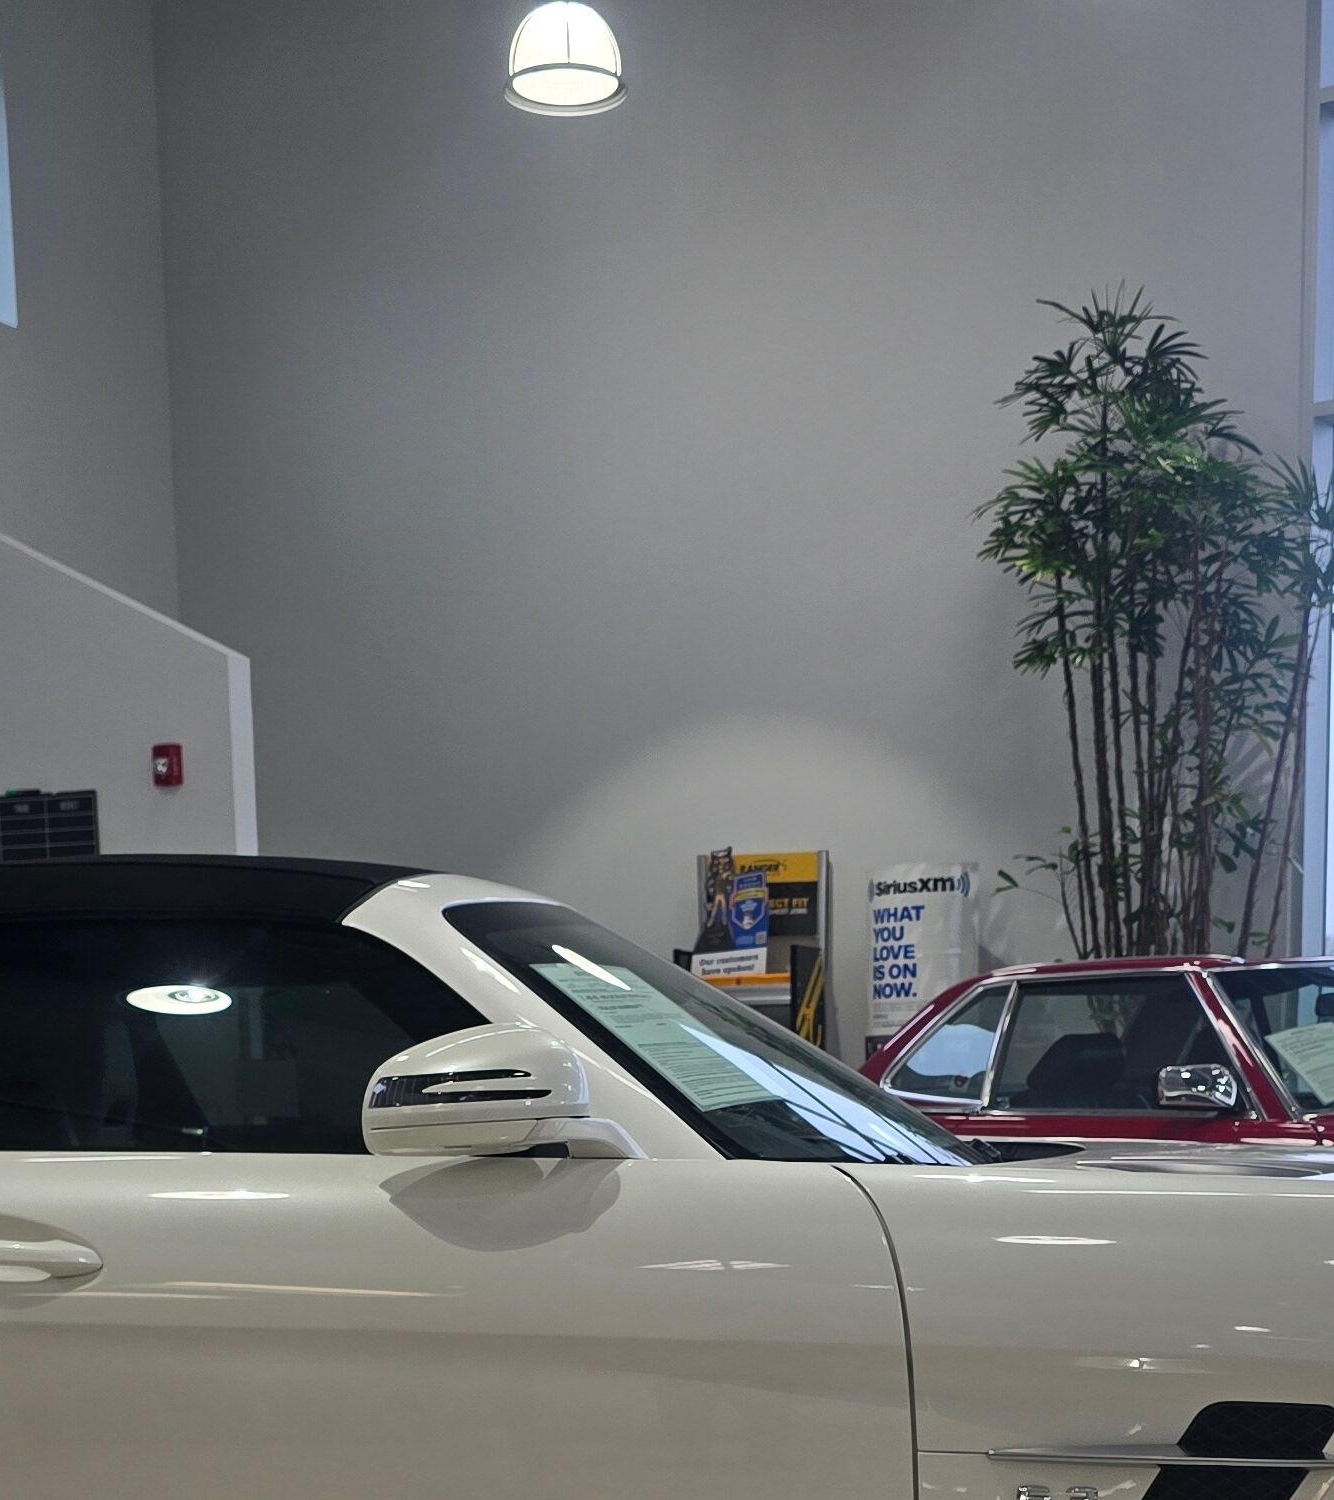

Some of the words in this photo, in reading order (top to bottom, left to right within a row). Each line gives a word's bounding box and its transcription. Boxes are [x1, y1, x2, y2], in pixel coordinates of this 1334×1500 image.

[873, 905, 925, 924] WHAT
[873, 926, 905, 943] YOU
[873, 944, 916, 962] LOVE
[873, 965, 885, 981] IS
[888, 963, 918, 980] ON
[873, 982, 918, 1000] NOW.
